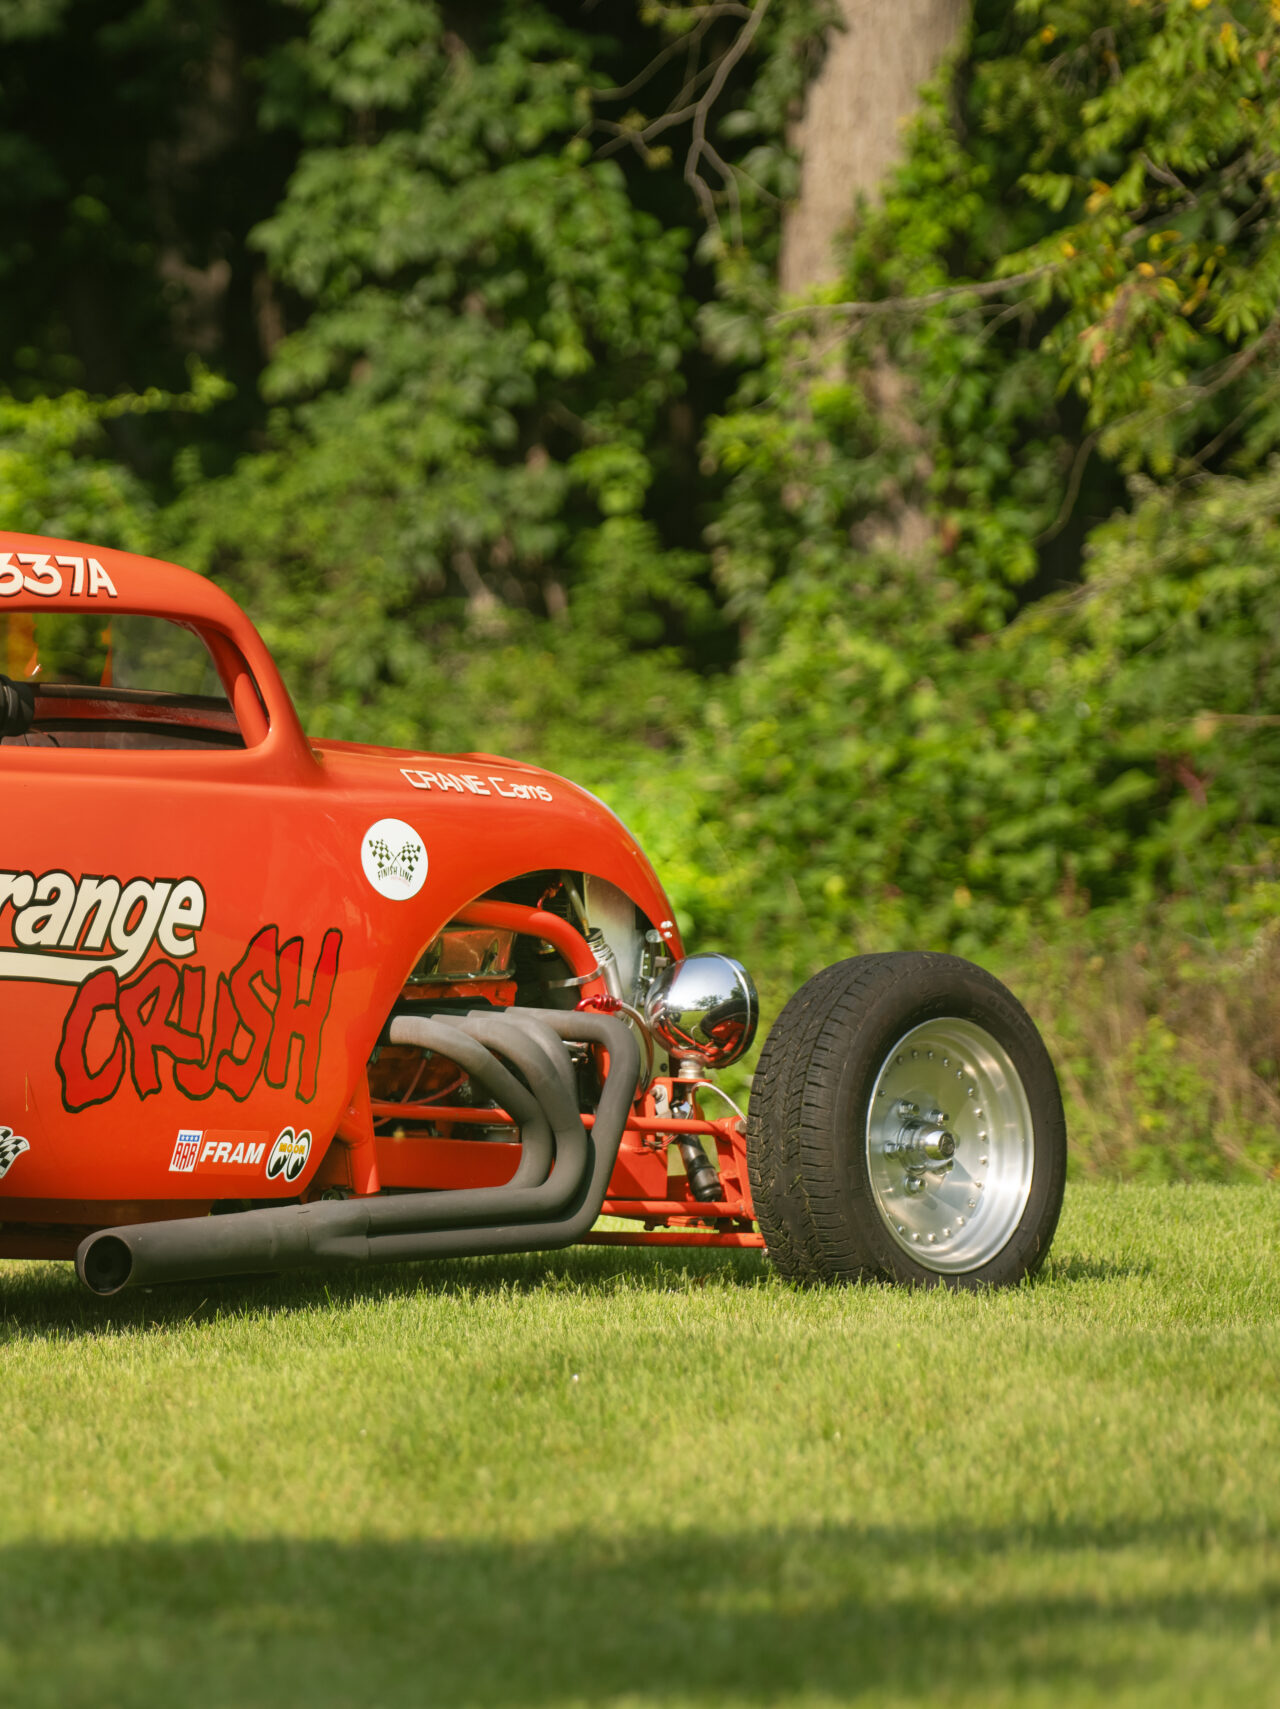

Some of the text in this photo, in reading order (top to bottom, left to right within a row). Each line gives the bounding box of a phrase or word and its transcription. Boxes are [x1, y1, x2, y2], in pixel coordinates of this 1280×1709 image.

[400, 768, 553, 802] CRANE Cams
[377, 865, 398, 881] FINISH
[399, 866, 413, 882] LINE
[55, 923, 342, 1114] CRUSH
[199, 1141, 267, 1164] FRAM
[278, 1142, 306, 1154] MOON
